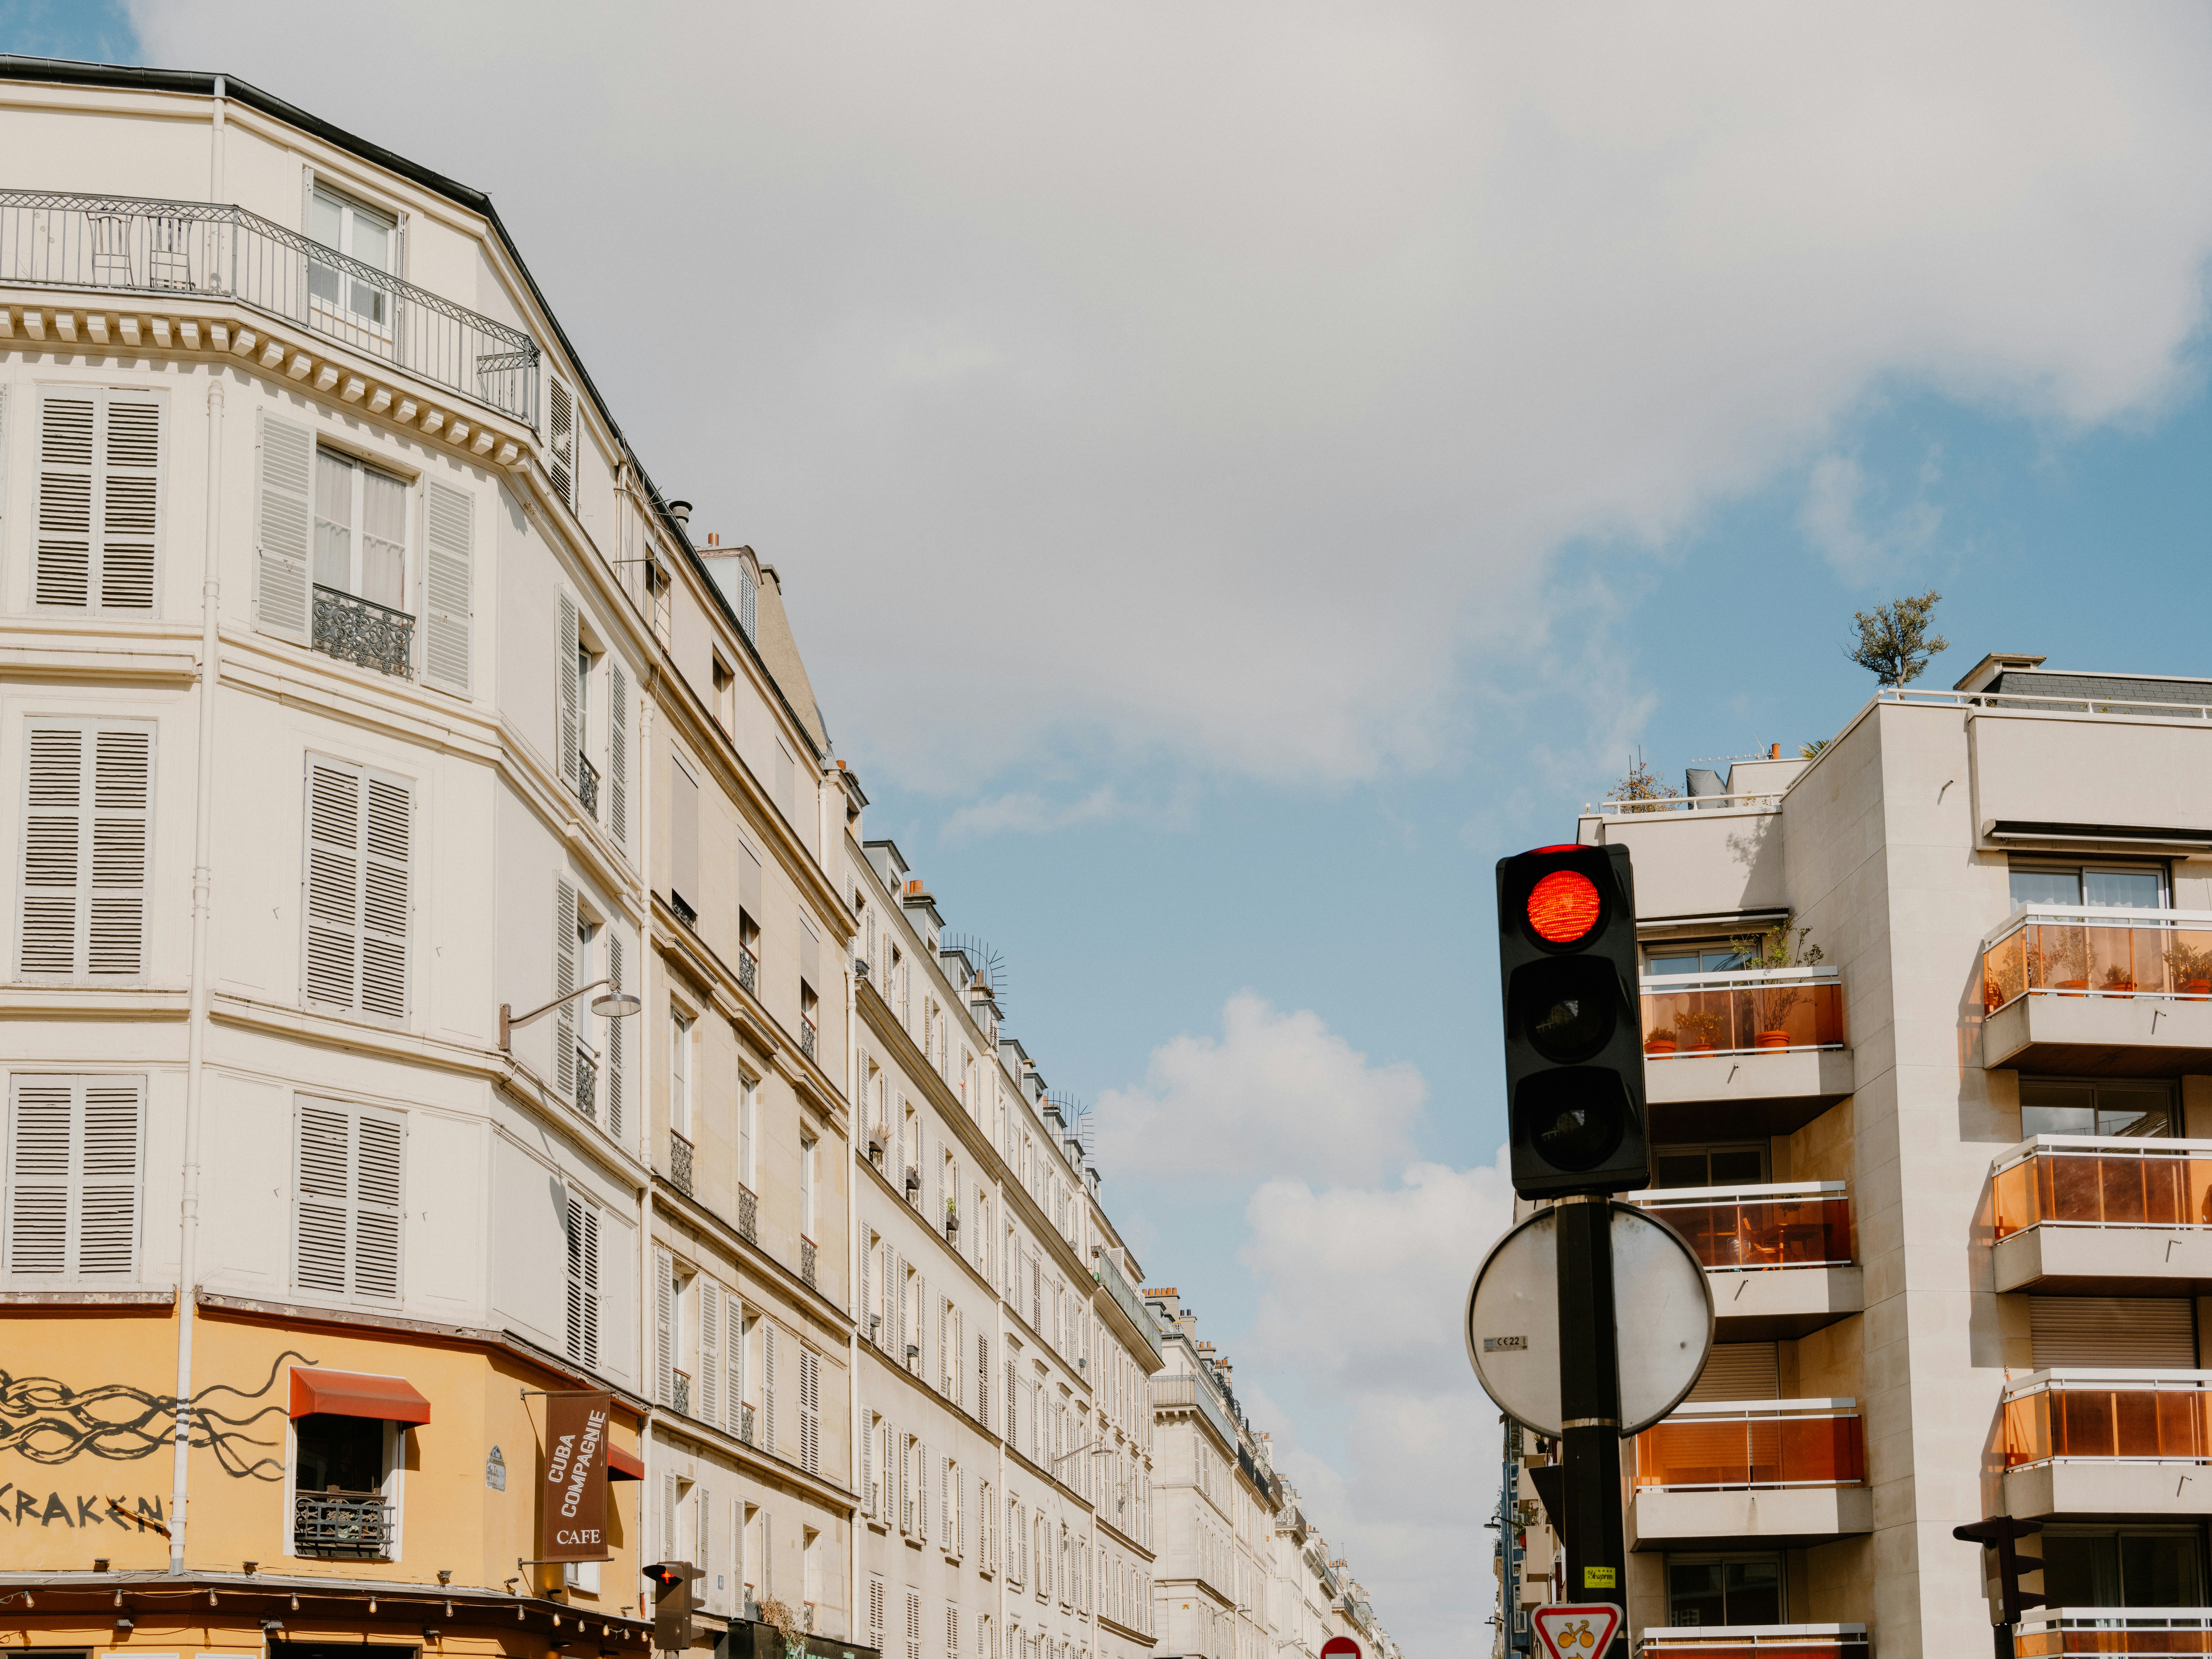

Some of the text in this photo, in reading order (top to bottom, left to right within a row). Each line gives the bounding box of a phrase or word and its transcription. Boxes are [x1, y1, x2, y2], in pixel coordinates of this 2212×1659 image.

[1497, 1338, 1508, 1346] CE
[1510, 1337, 1519, 1345] 22
[549, 1435, 575, 1483] CUBA
[561, 1410, 605, 1517] COMPAGNIE
[557, 1529, 601, 1544] CAFE
[719, 1577, 723, 1588] 41
